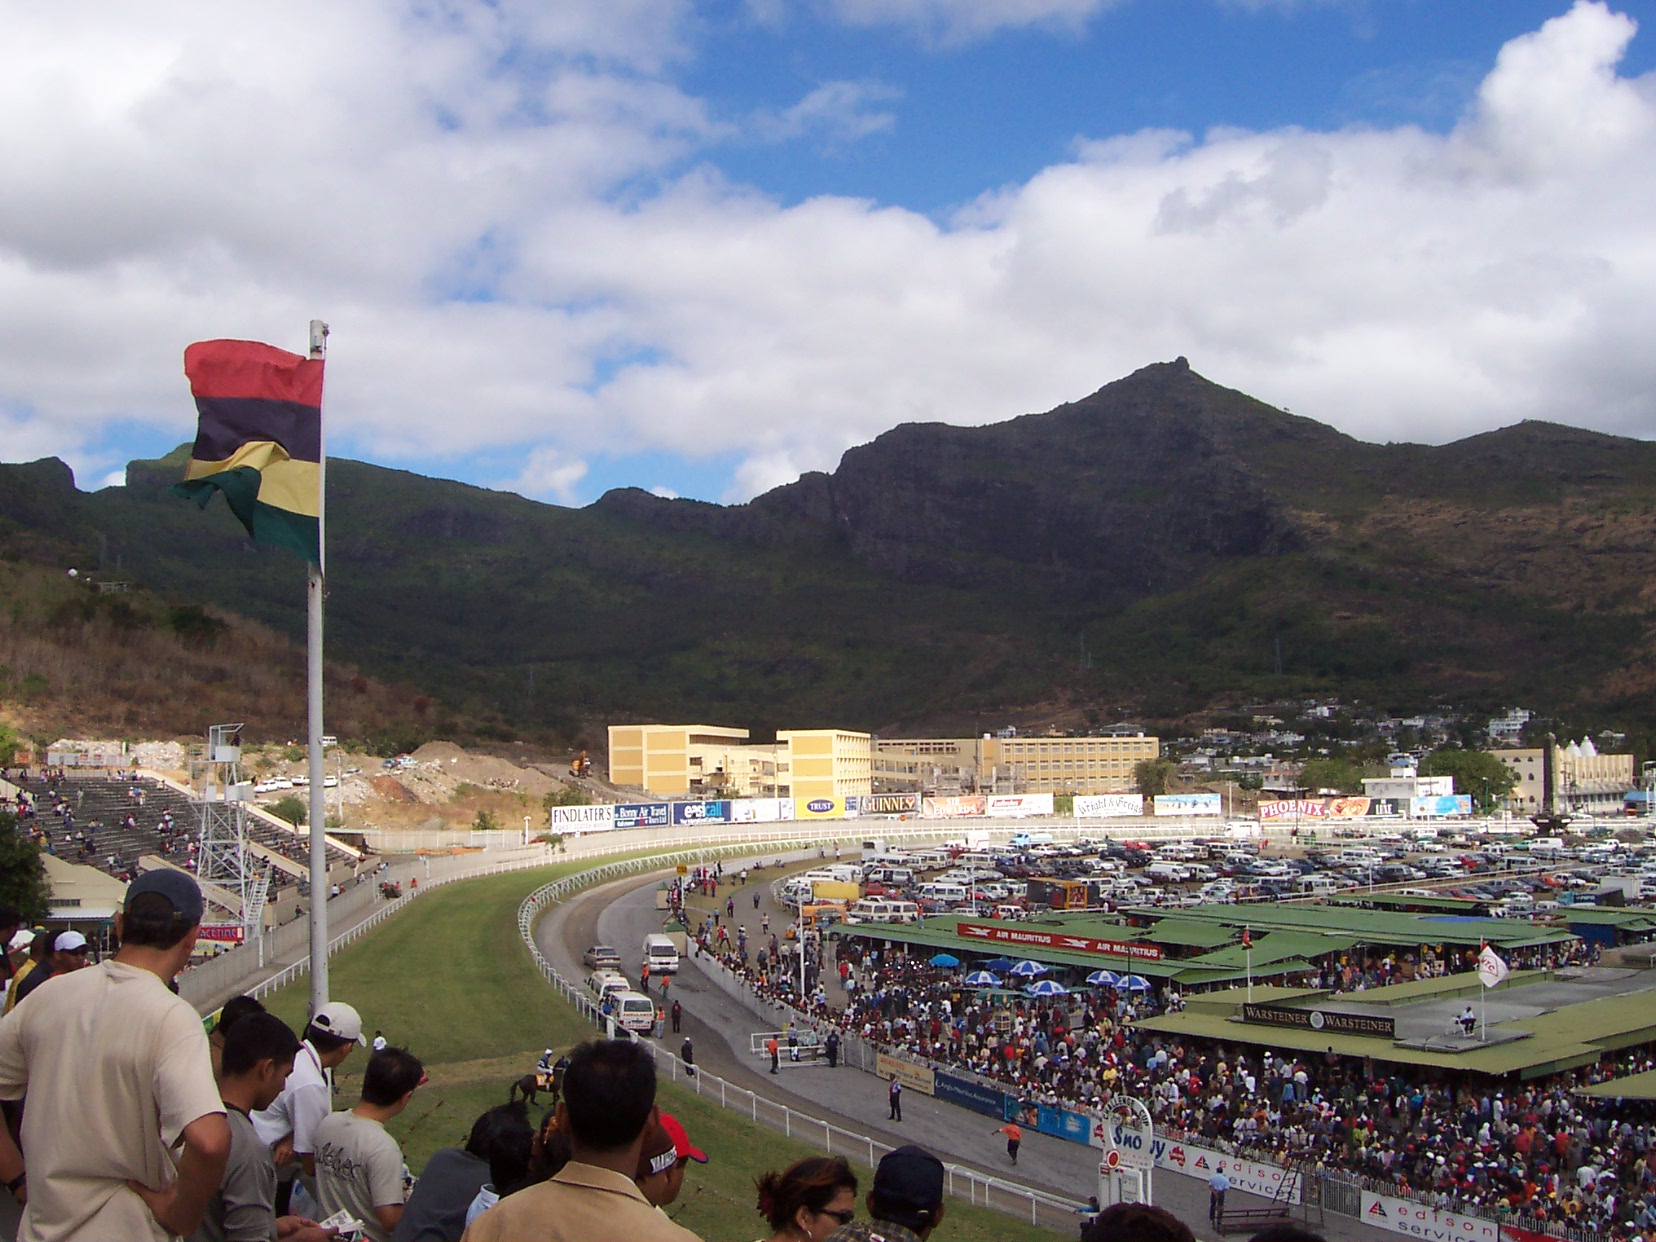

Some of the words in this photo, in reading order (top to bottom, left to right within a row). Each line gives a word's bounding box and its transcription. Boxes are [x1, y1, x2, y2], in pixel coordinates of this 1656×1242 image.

[554, 807, 612, 823] FINDLATER'S
[684, 801, 722, 818] easicall
[810, 802, 832, 811] TRUST
[1260, 800, 1323, 818] PHOENIX
[996, 930, 1009, 939] AIR
[1010, 932, 1051, 944] MAURITIUS
[1097, 943, 1111, 952] AIR
[1113, 944, 1158, 957] MAURITIUS
[1246, 1006, 1308, 1024] WARSTEINER
[1324, 1014, 1393, 1032] WARSTEINER
[1103, 1097, 1134, 1120] CHALLENGE
[1139, 1109, 1150, 1127] CUP
[1218, 1160, 1296, 1185] edison
[1224, 1175, 1297, 1201] ervices
[1398, 1206, 1493, 1237] edison
[1398, 1221, 1477, 1242] servic
